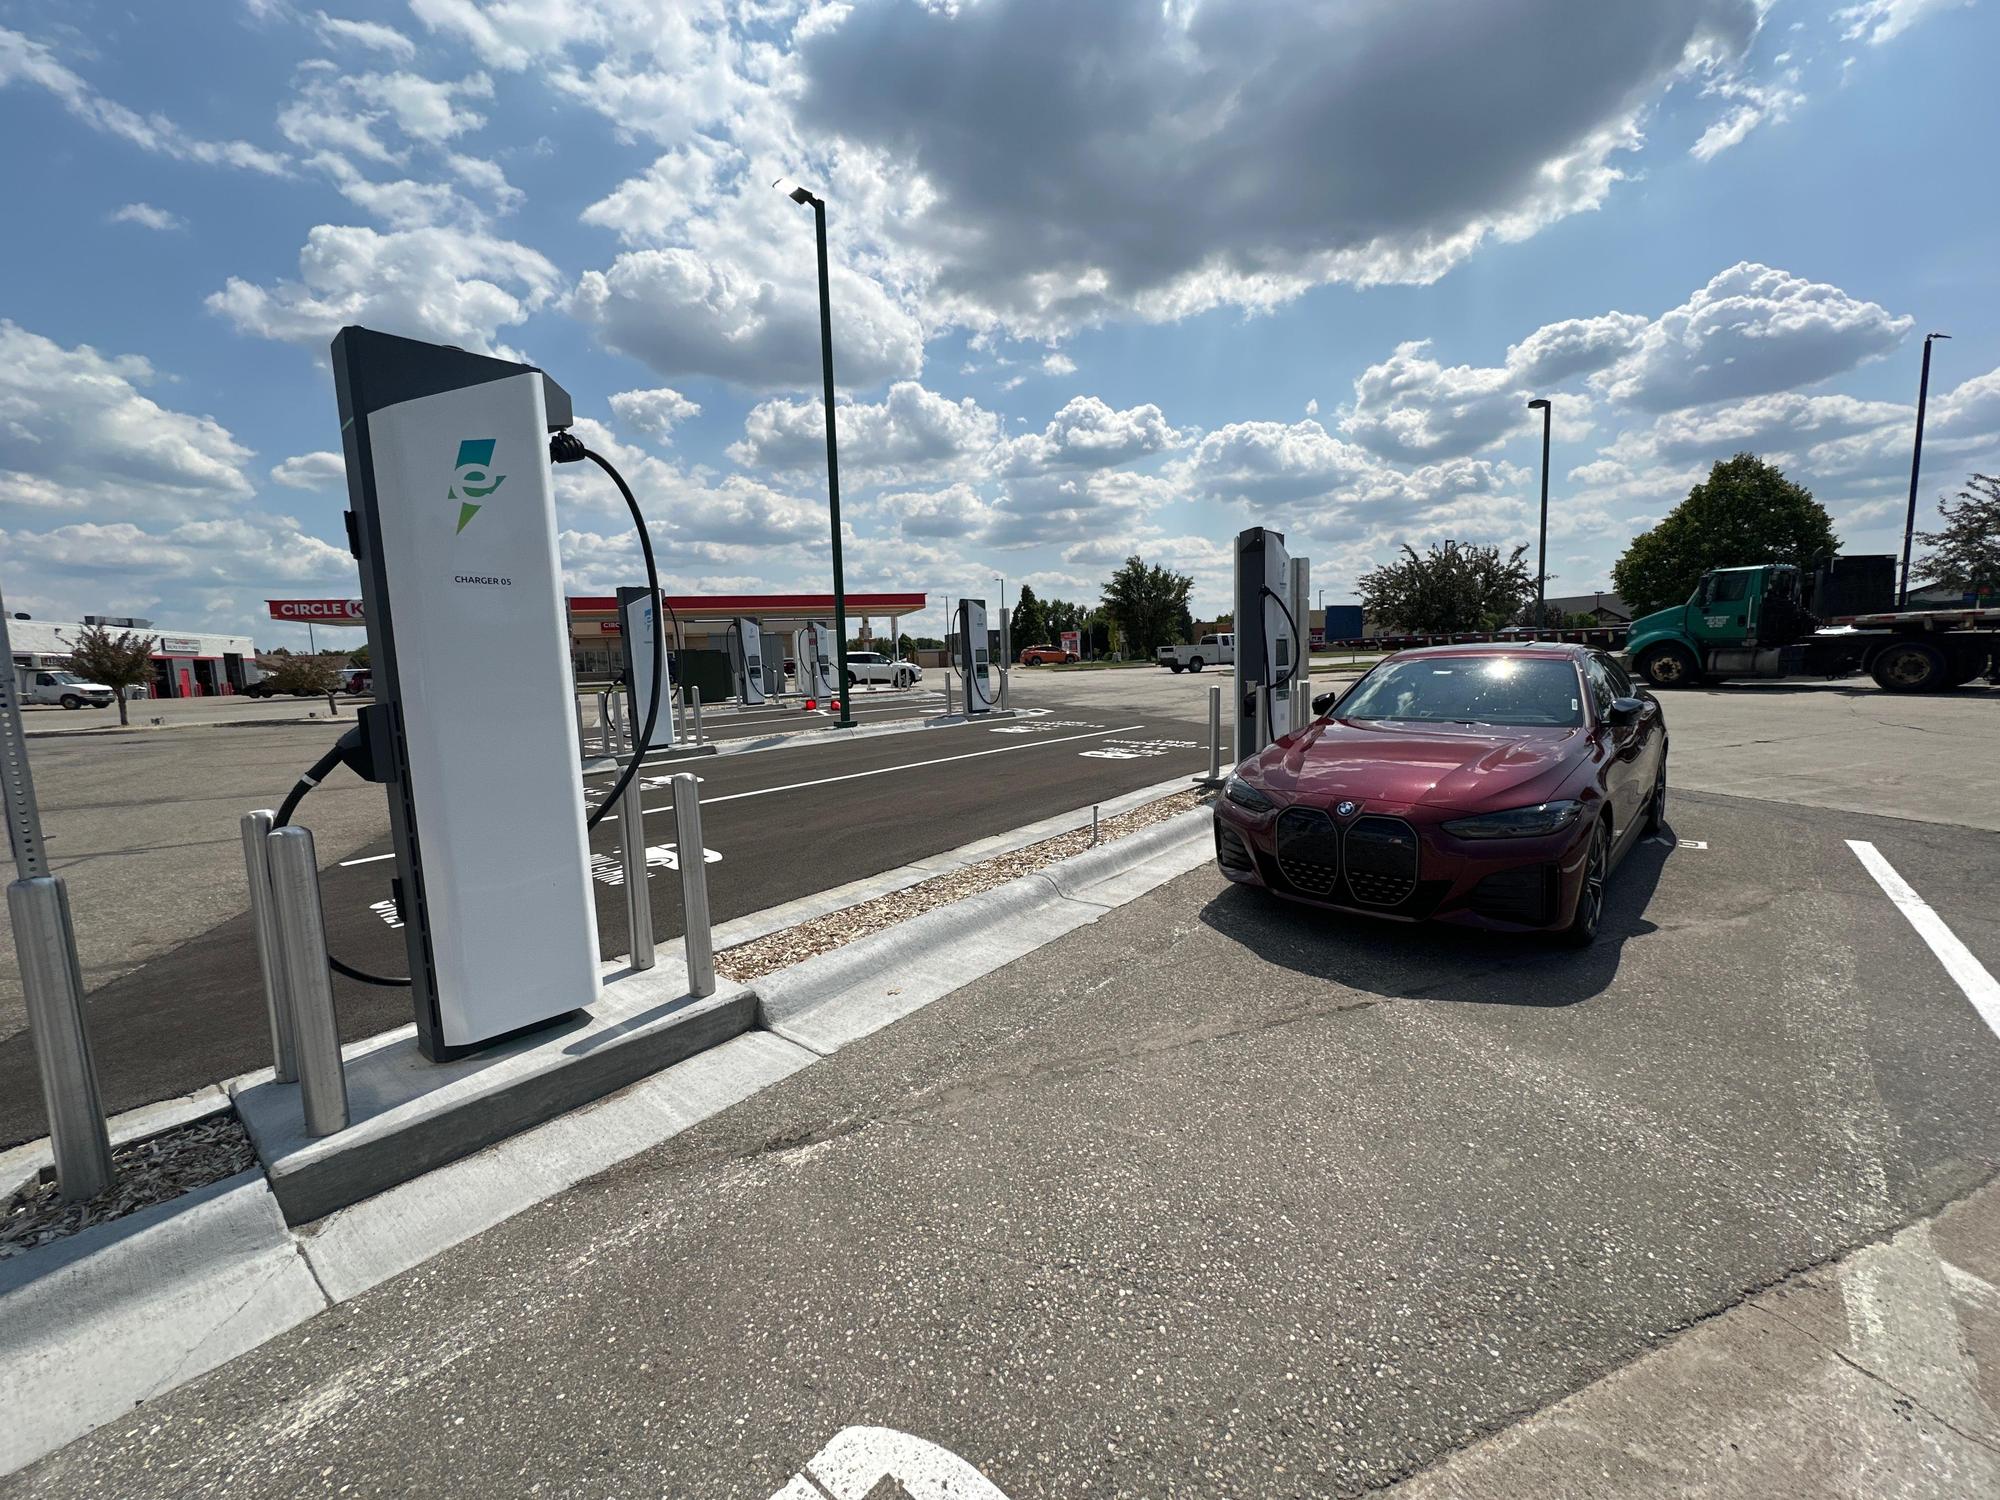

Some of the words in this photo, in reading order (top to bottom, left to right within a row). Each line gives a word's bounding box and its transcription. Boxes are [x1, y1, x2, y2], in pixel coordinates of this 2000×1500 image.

[455, 575, 499, 585] CHARGER
[500, 578, 512, 586] 05
[281, 603, 342, 615] CIRCLE
